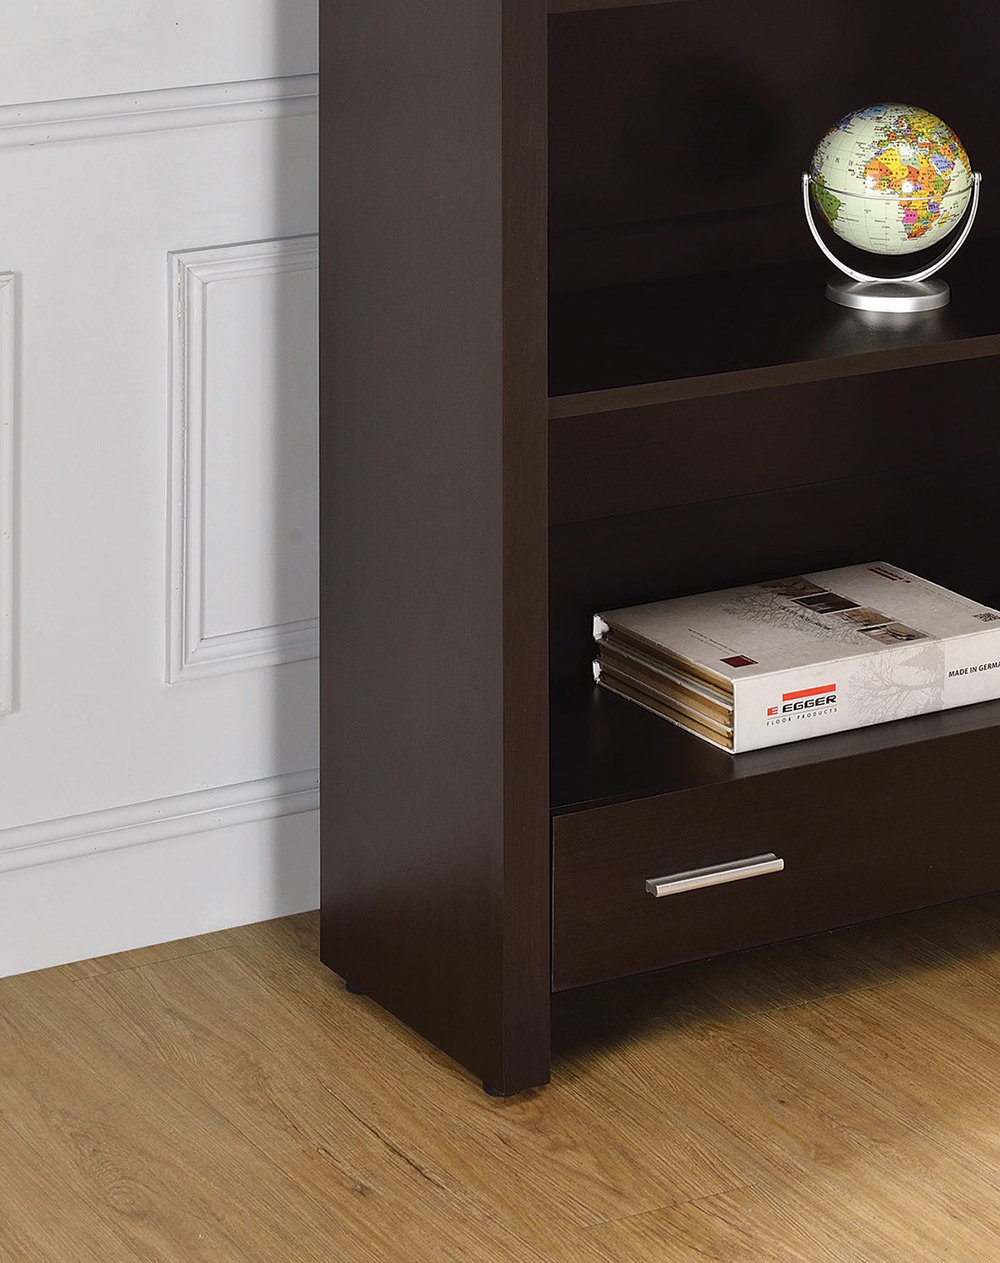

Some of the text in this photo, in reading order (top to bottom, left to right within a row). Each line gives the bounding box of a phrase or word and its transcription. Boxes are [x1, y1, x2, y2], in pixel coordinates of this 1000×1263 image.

[947, 665, 969, 678] MADE
[969, 665, 978, 674] IN
[782, 694, 837, 714] EGGER
[766, 707, 838, 726] FLOOR PRODUCTS
